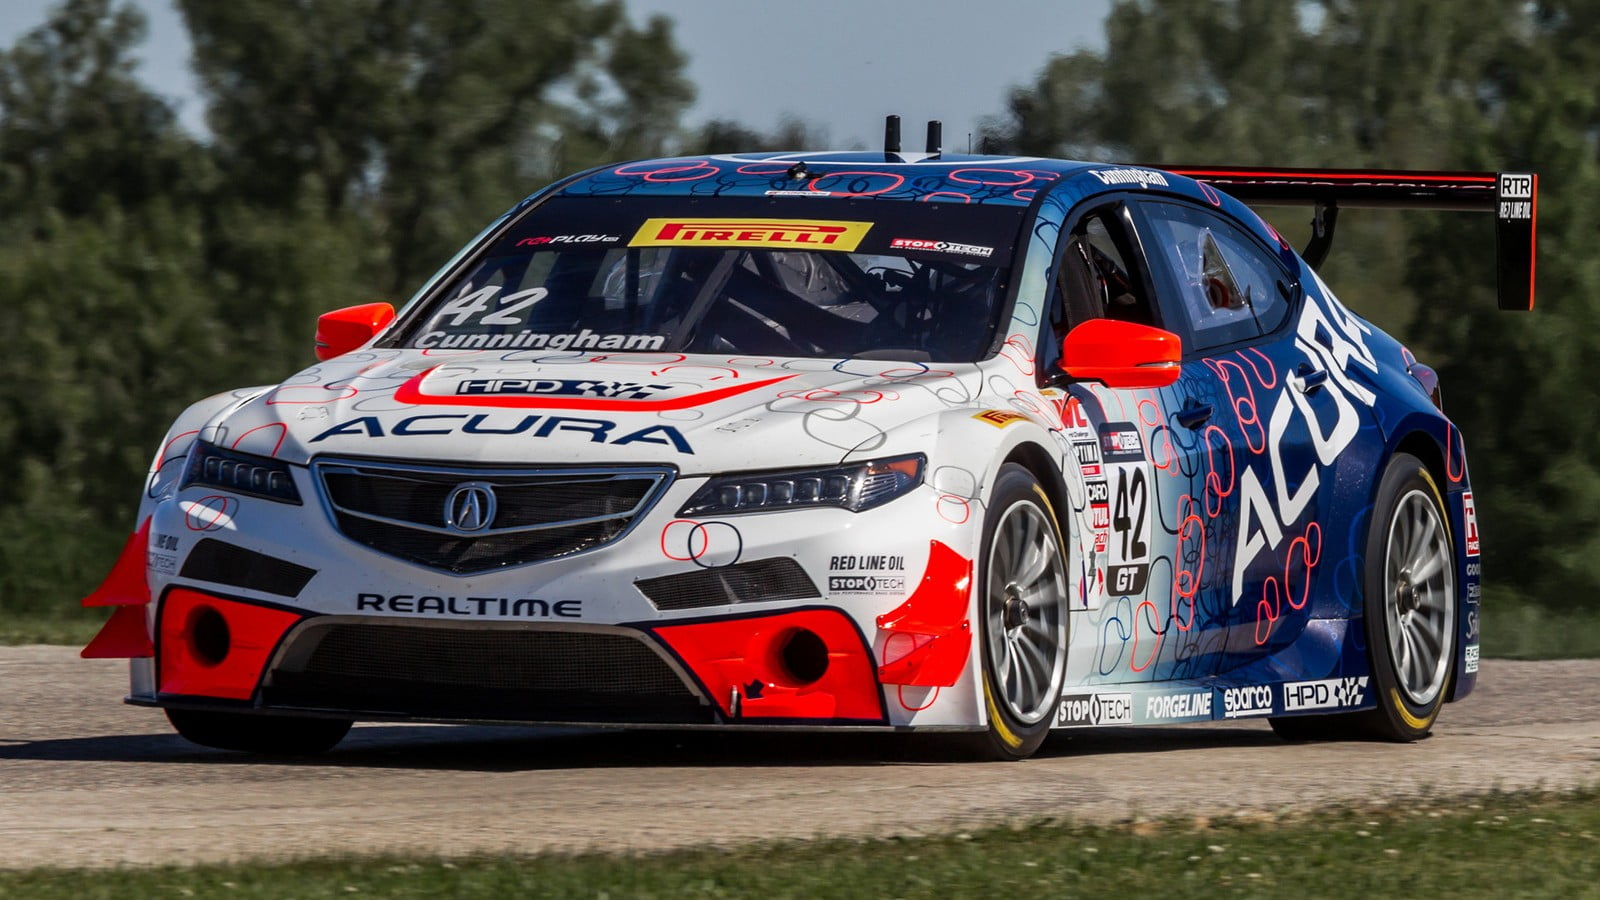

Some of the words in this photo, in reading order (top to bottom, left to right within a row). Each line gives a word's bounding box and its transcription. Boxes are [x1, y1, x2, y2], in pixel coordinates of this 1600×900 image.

[1087, 167, 1169, 189] Cunningham
[1502, 177, 1530, 195] RTR
[655, 223, 848, 244] PIRELLI
[439, 285, 549, 326] 42
[414, 329, 665, 351] Cunningham
[459, 379, 563, 395] HPD
[307, 414, 696, 456] ACURA
[1231, 264, 1378, 608] ACURA
[1113, 466, 1147, 562] 42
[829, 555, 856, 570] RED
[859, 555, 886, 570] LINE
[888, 556, 905, 570] OIL
[1116, 567, 1138, 592] GT
[356, 593, 582, 618] REALTIME
[1146, 692, 1213, 719] FORGELINE
[1224, 685, 1272, 718] sparco
[1286, 683, 1330, 707] HPD
